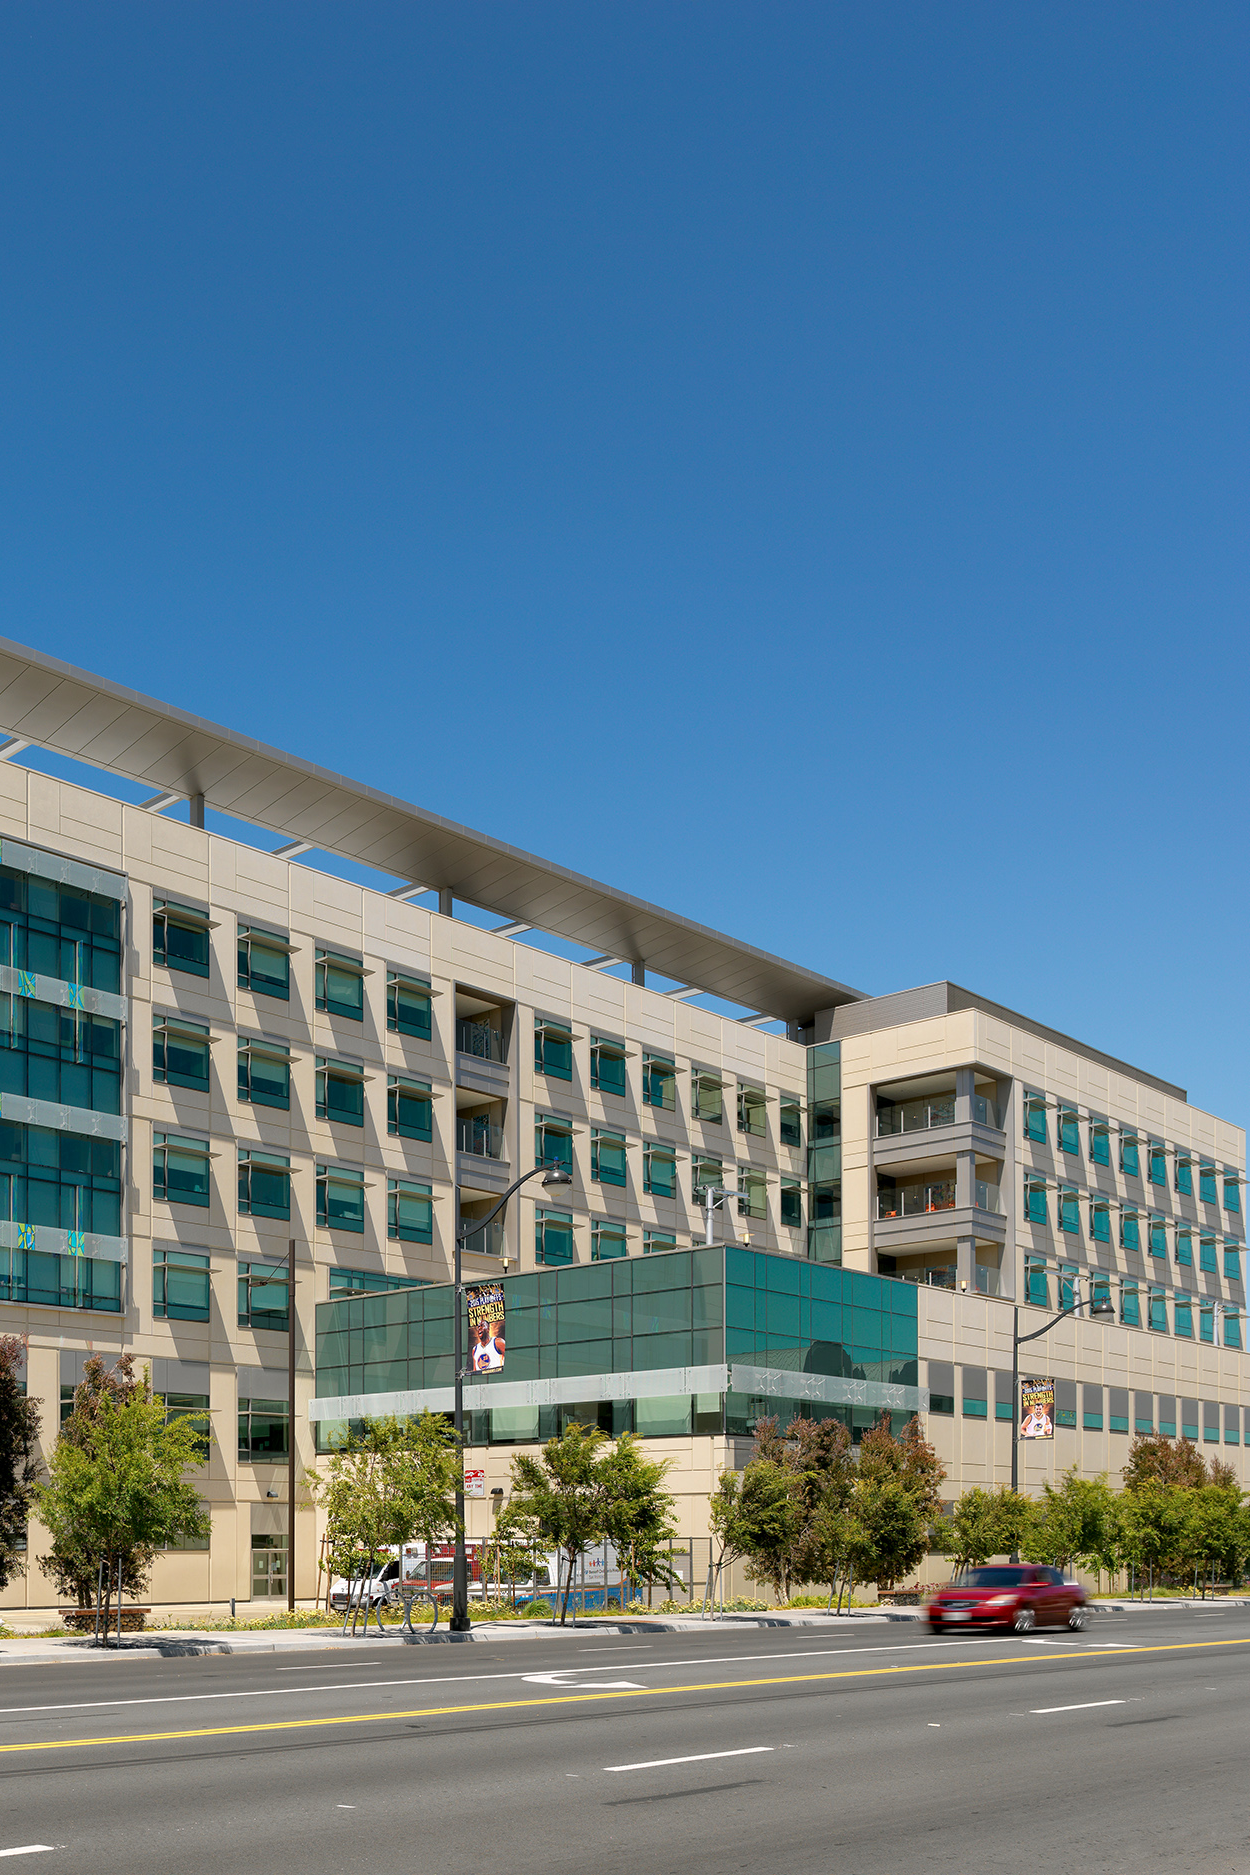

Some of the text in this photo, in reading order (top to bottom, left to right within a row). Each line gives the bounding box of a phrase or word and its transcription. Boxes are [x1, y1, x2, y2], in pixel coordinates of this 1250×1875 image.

[468, 1301, 504, 1318] STRENGTH
[469, 1317, 477, 1327] IN
[1022, 1390, 1054, 1401] STRENGTH
